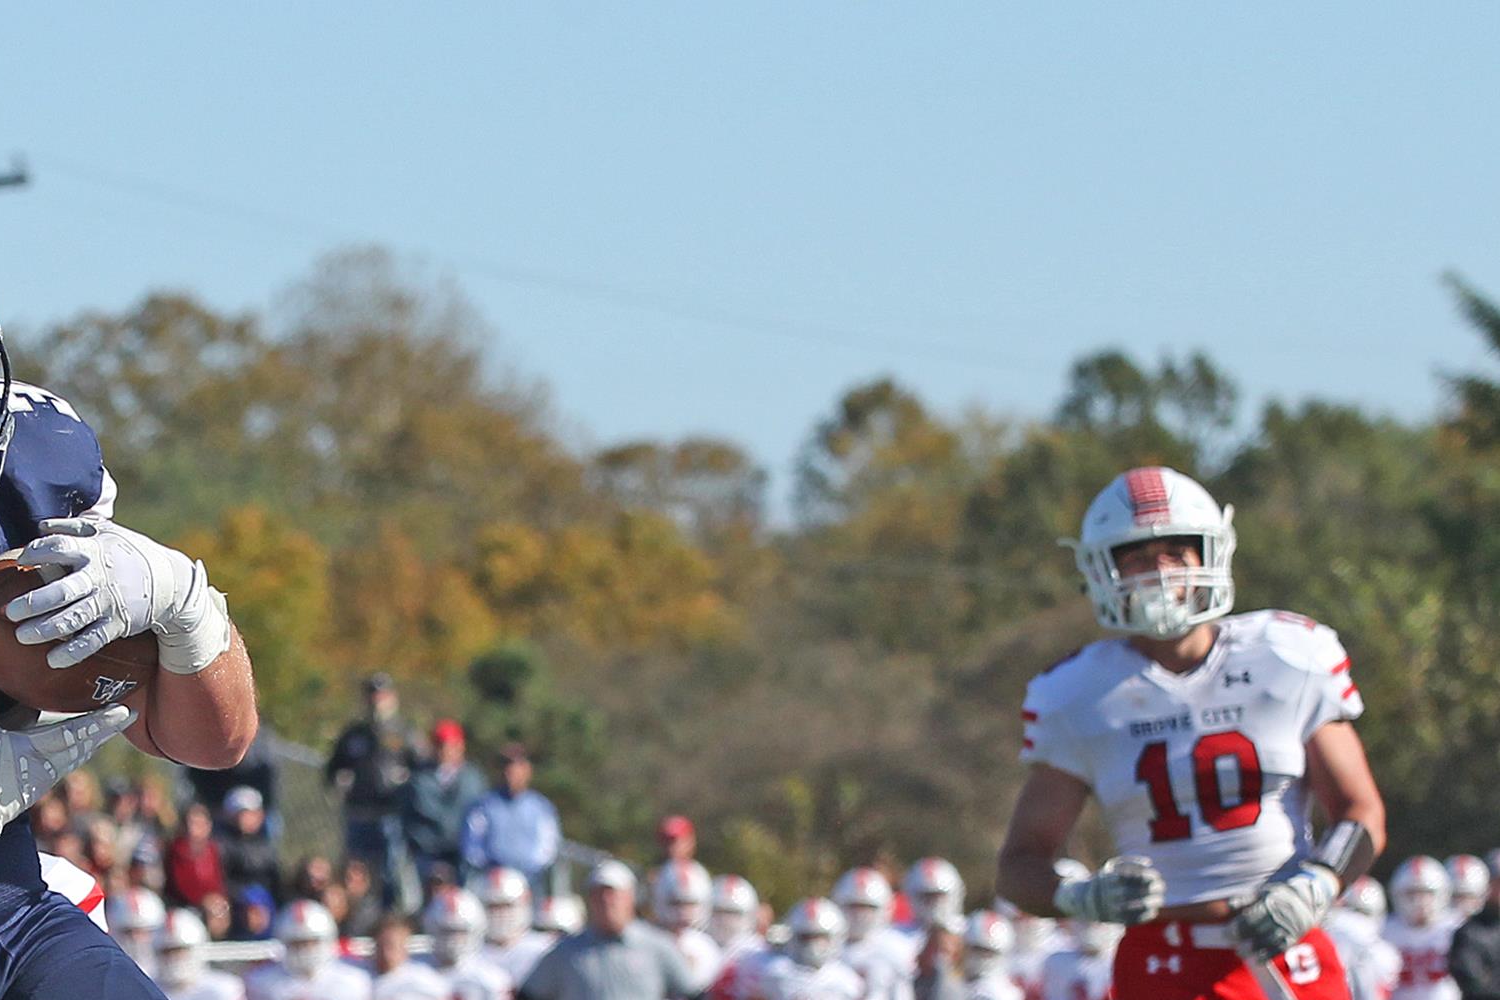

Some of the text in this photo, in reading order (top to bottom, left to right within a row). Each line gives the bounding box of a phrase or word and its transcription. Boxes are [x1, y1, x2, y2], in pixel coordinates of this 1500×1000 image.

[1128, 705, 1244, 738] GROVE CITY
[1135, 730, 1262, 844] 10
